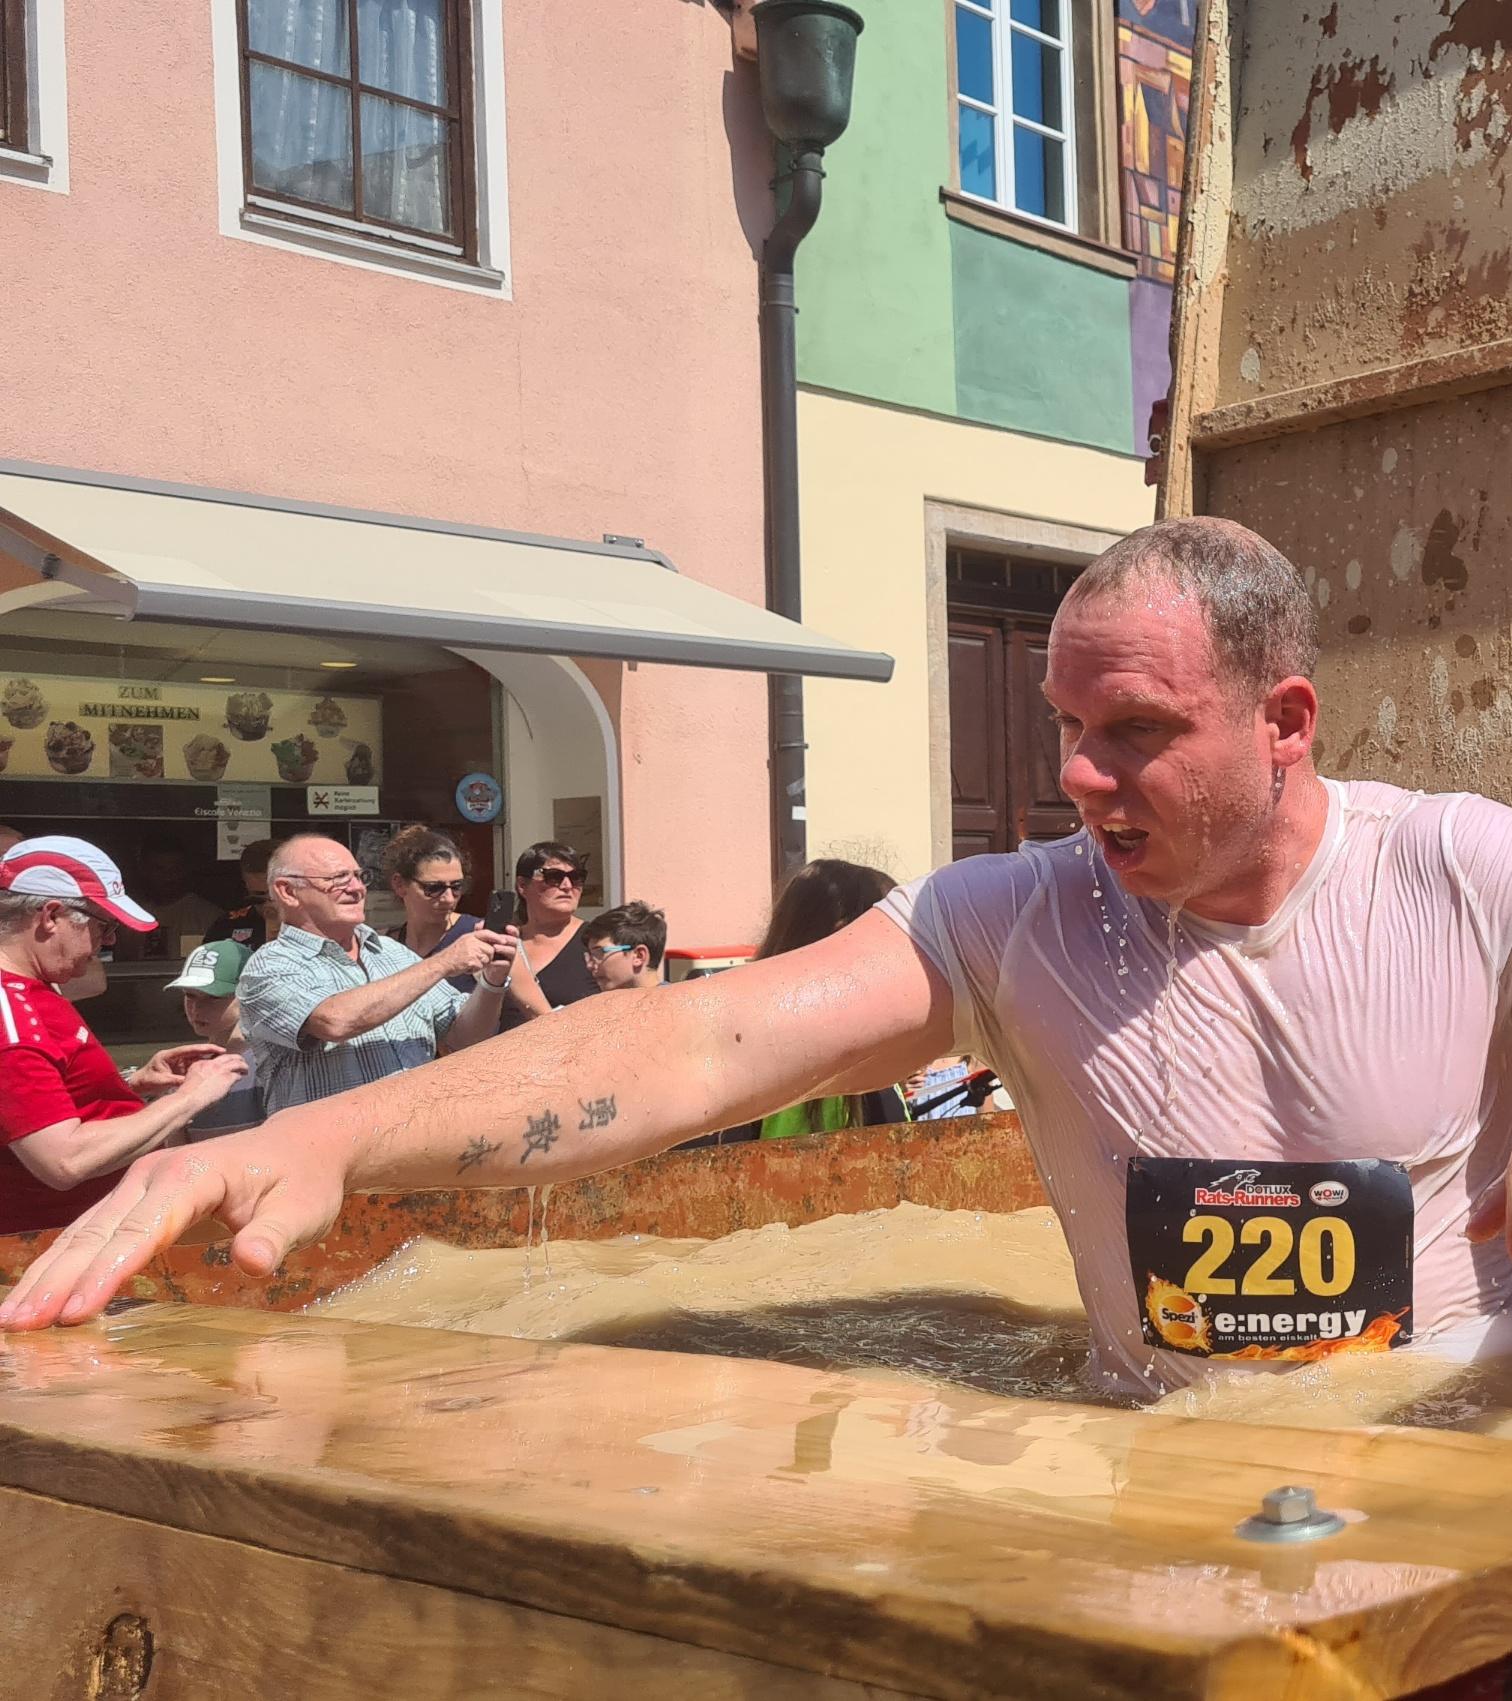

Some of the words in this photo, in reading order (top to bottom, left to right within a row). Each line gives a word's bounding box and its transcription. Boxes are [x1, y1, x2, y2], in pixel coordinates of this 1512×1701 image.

[119, 686, 160, 700] ZUM
[83, 703, 200, 720] MITNEHMEN
[1195, 1187, 1302, 1208] Rats-Runners
[1246, 1184, 1291, 1195] DOTLUX
[1182, 1215, 1356, 1297] 220
[1161, 1307, 1196, 1324] Spezi
[1214, 1309, 1367, 1339] e:nergy
[1238, 1333, 1277, 1342] besten
[1279, 1333, 1318, 1342] eiskalt
